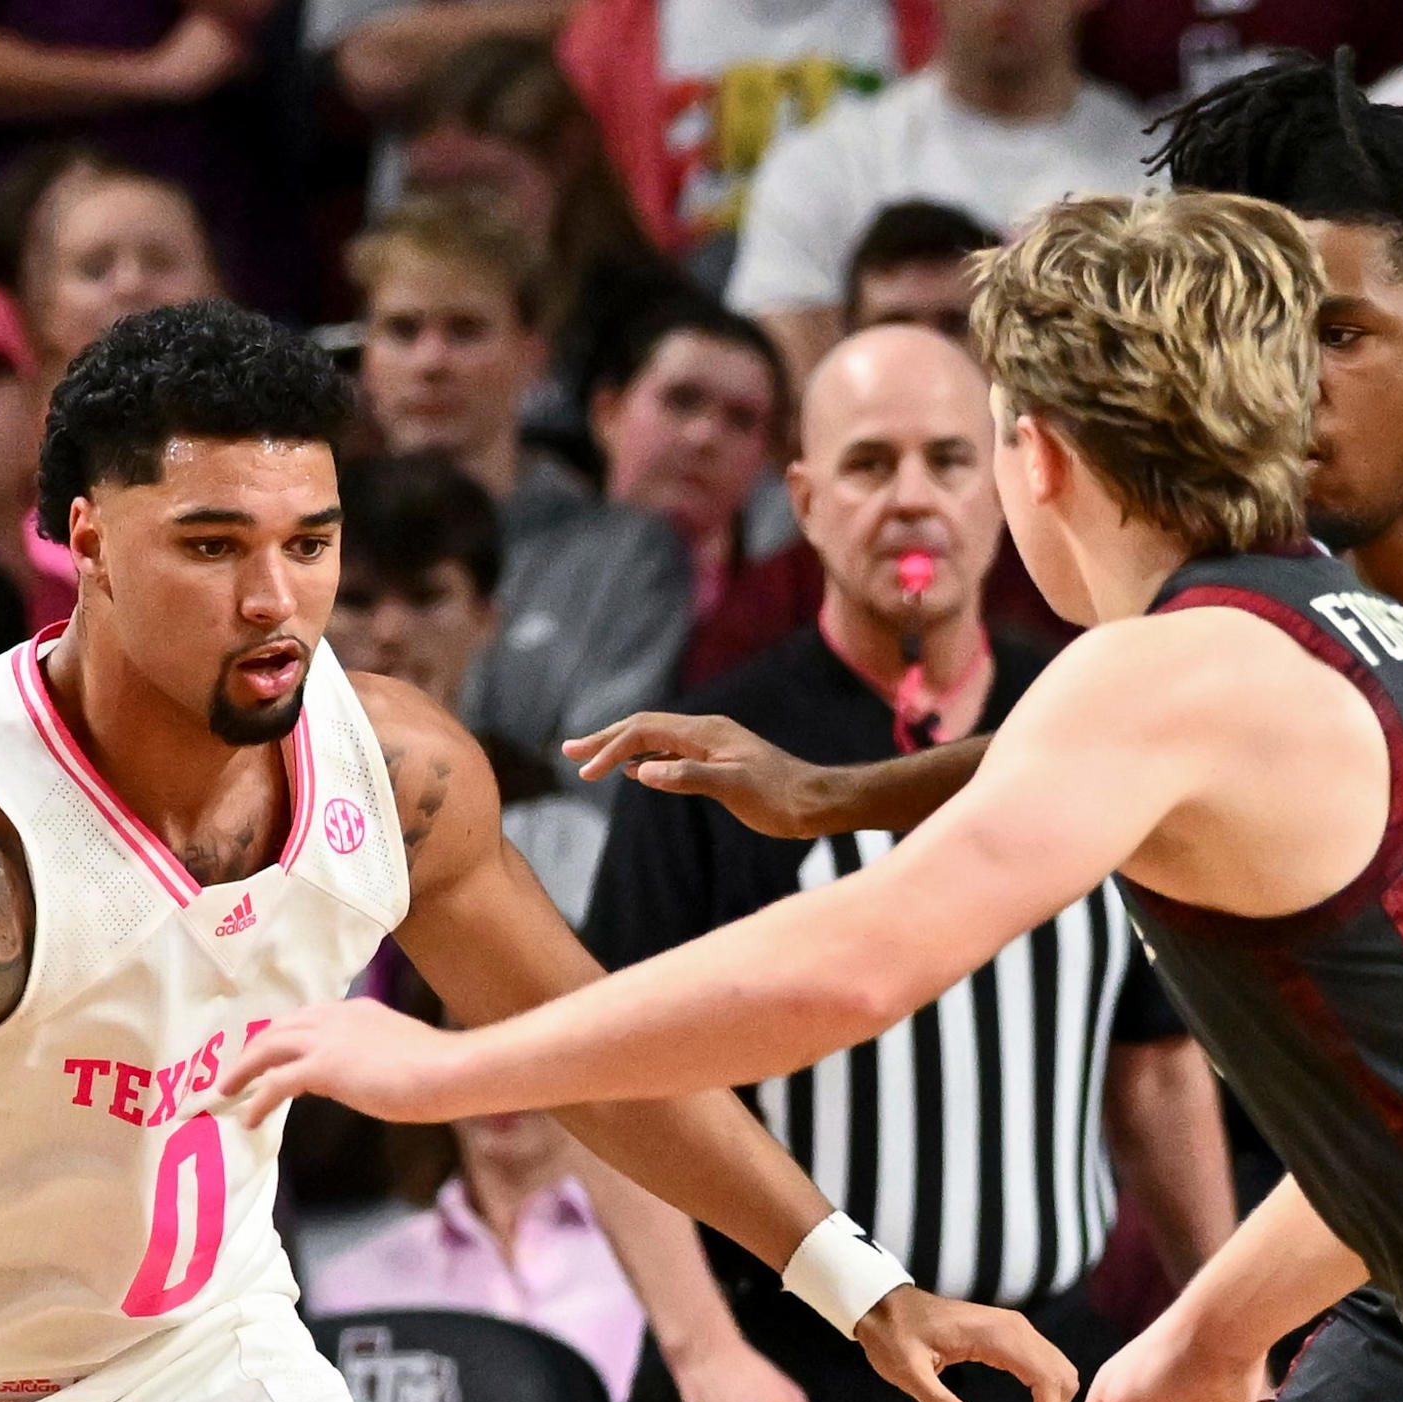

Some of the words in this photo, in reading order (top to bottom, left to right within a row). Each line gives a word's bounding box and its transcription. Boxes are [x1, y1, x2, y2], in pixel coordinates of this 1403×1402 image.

[325, 799, 364, 853] SEC
[215, 914, 257, 937] adidas
[121, 1110, 226, 1317] 0
